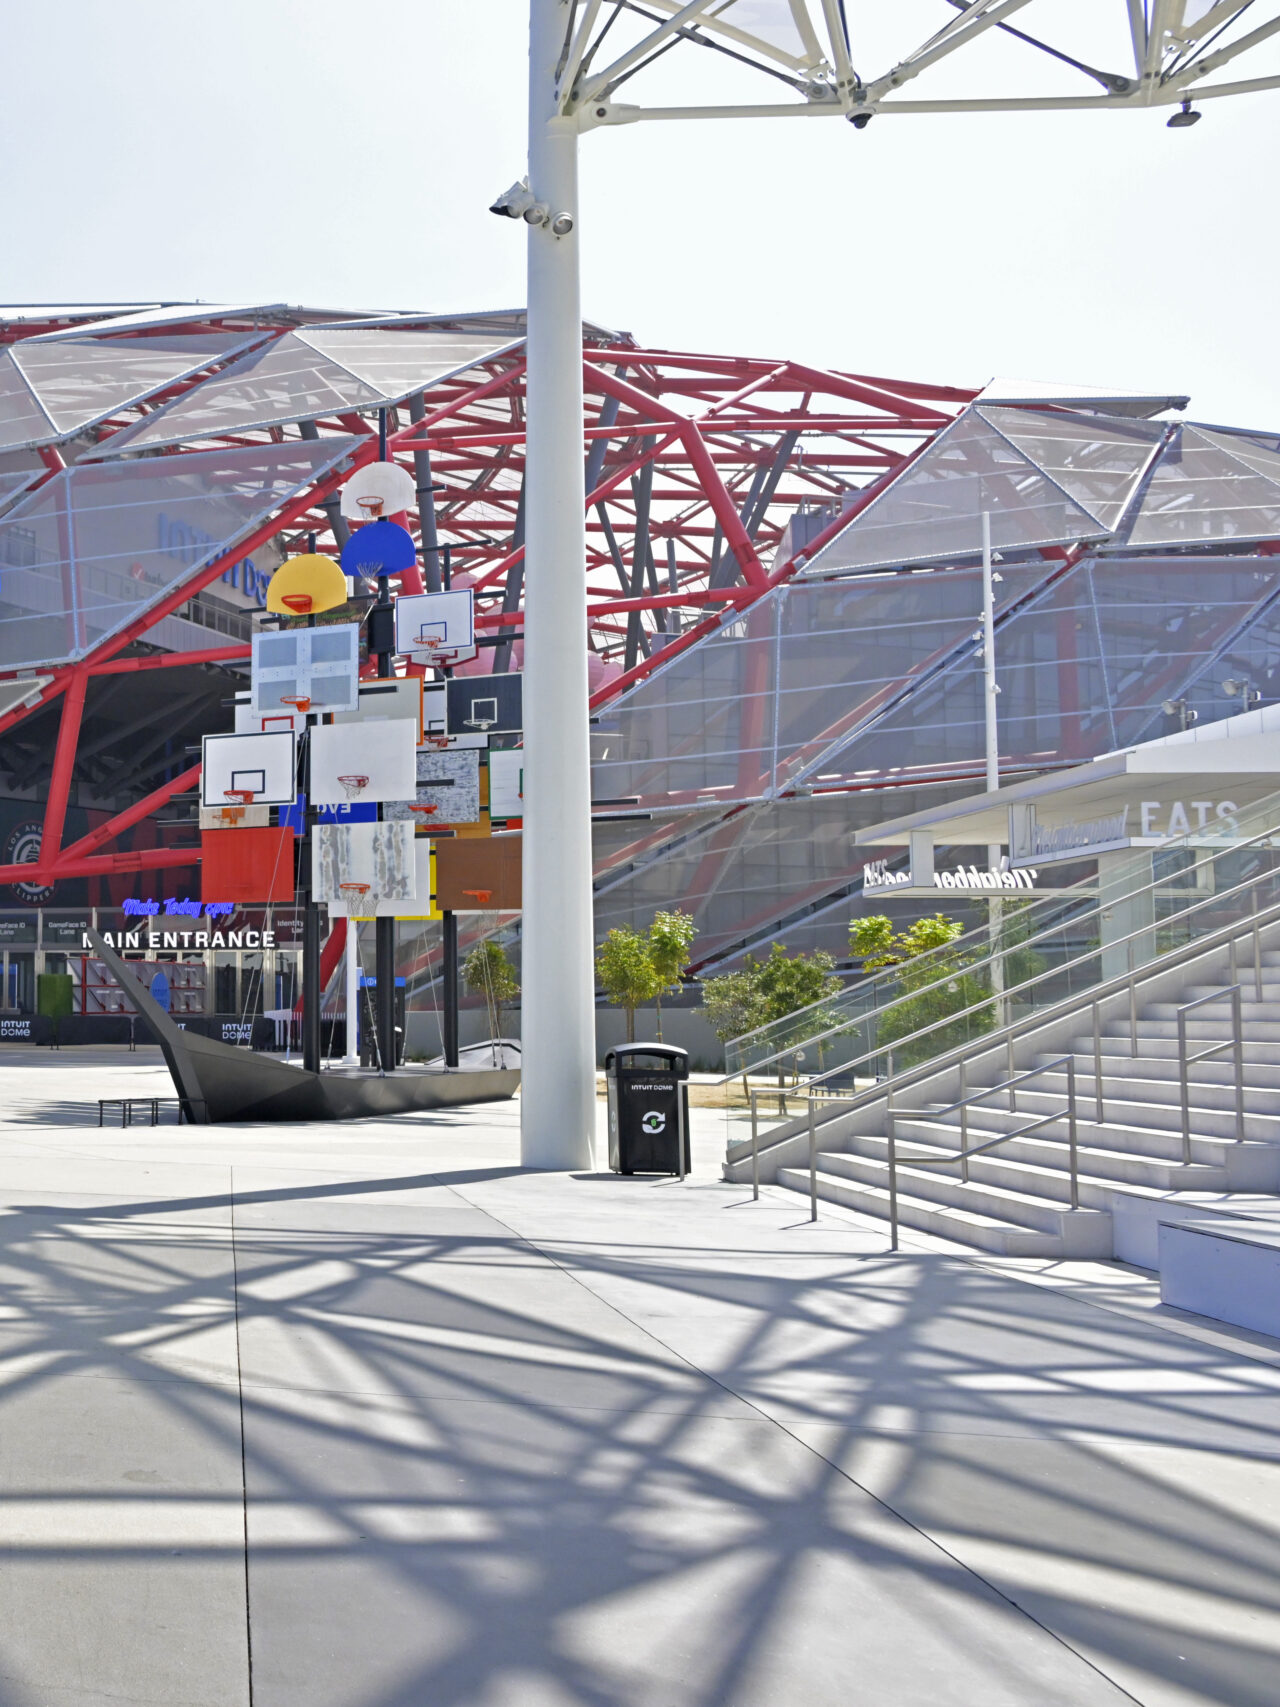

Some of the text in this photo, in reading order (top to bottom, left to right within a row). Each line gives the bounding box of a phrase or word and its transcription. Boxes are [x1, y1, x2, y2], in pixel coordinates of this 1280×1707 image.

[1141, 800, 1240, 838] EATS
[122, 898, 160, 917] Make
[163, 897, 204, 919] Today
[149, 931, 275, 948] ENTRANCE
[1, 1020, 30, 1028] INTUIT
